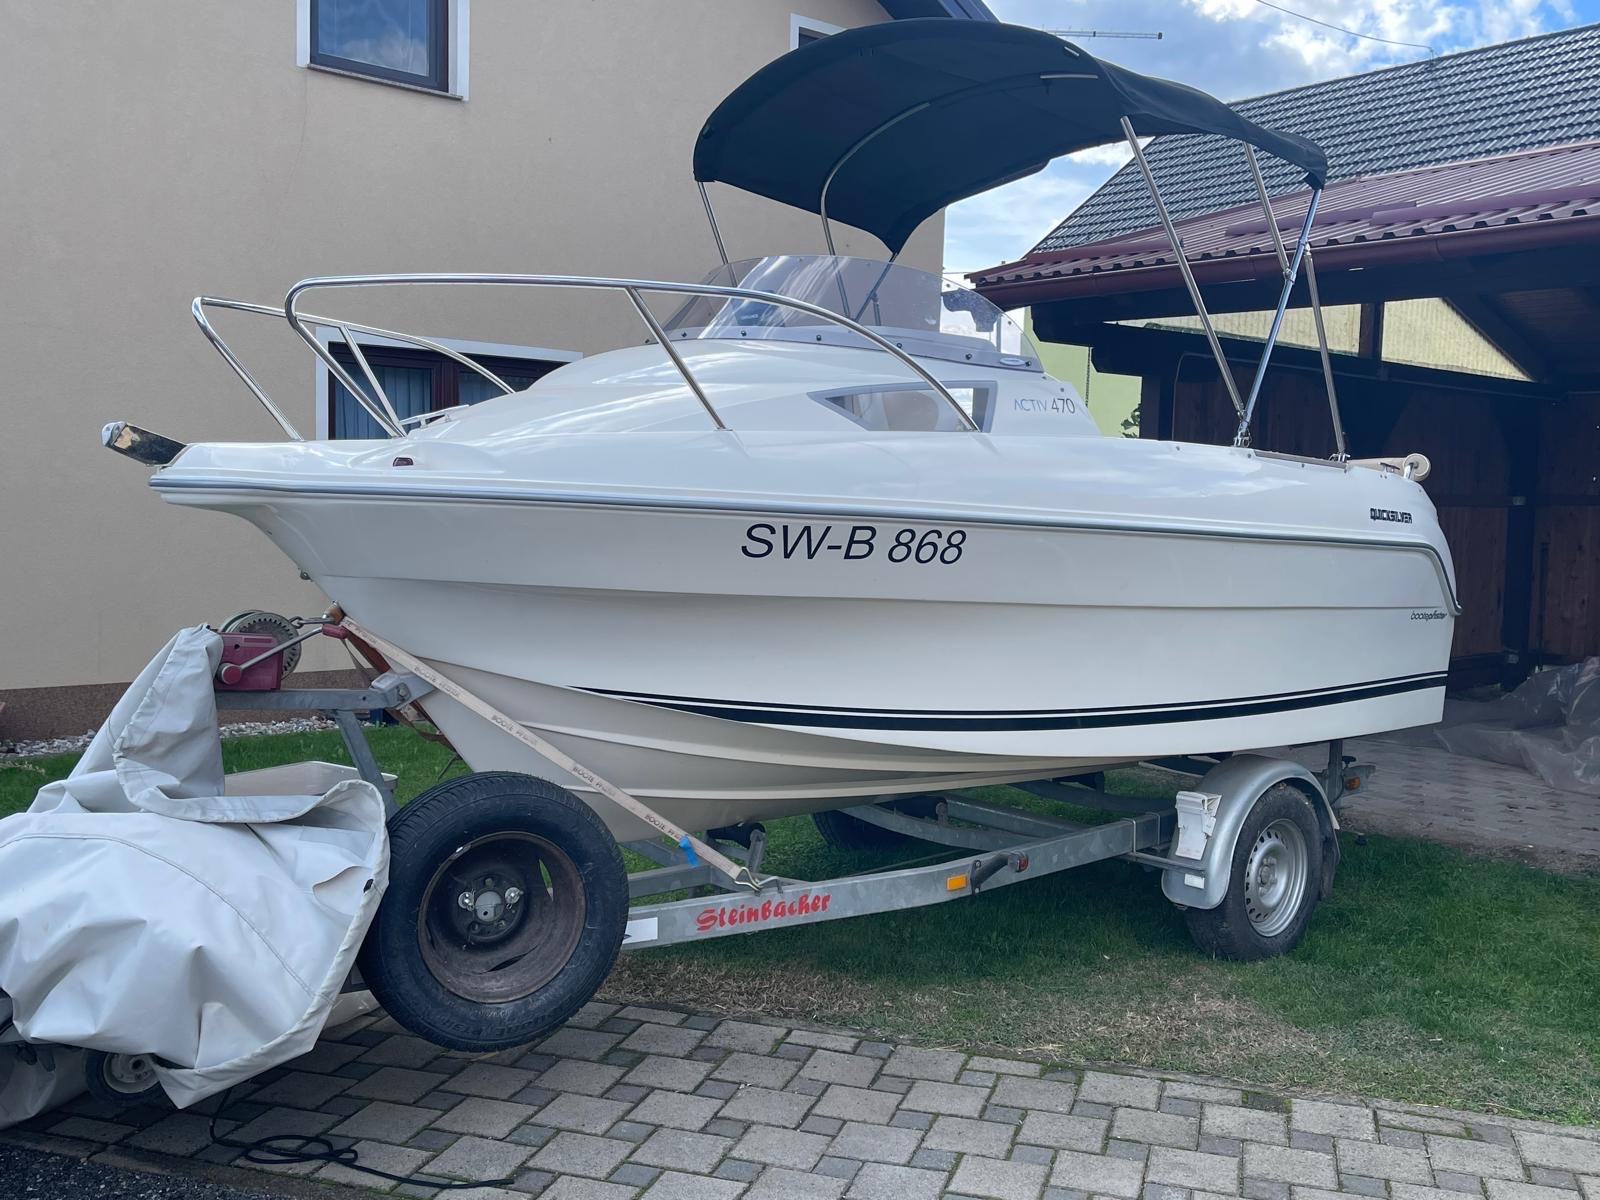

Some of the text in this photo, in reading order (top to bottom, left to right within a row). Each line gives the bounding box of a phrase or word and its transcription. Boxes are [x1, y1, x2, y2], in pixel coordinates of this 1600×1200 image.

[1014, 398, 1076, 414] ACTIV 470
[1370, 507, 1413, 524] QUICKSILVER
[741, 523, 967, 565] SW-B 868
[694, 893, 832, 933] Steinbacher
